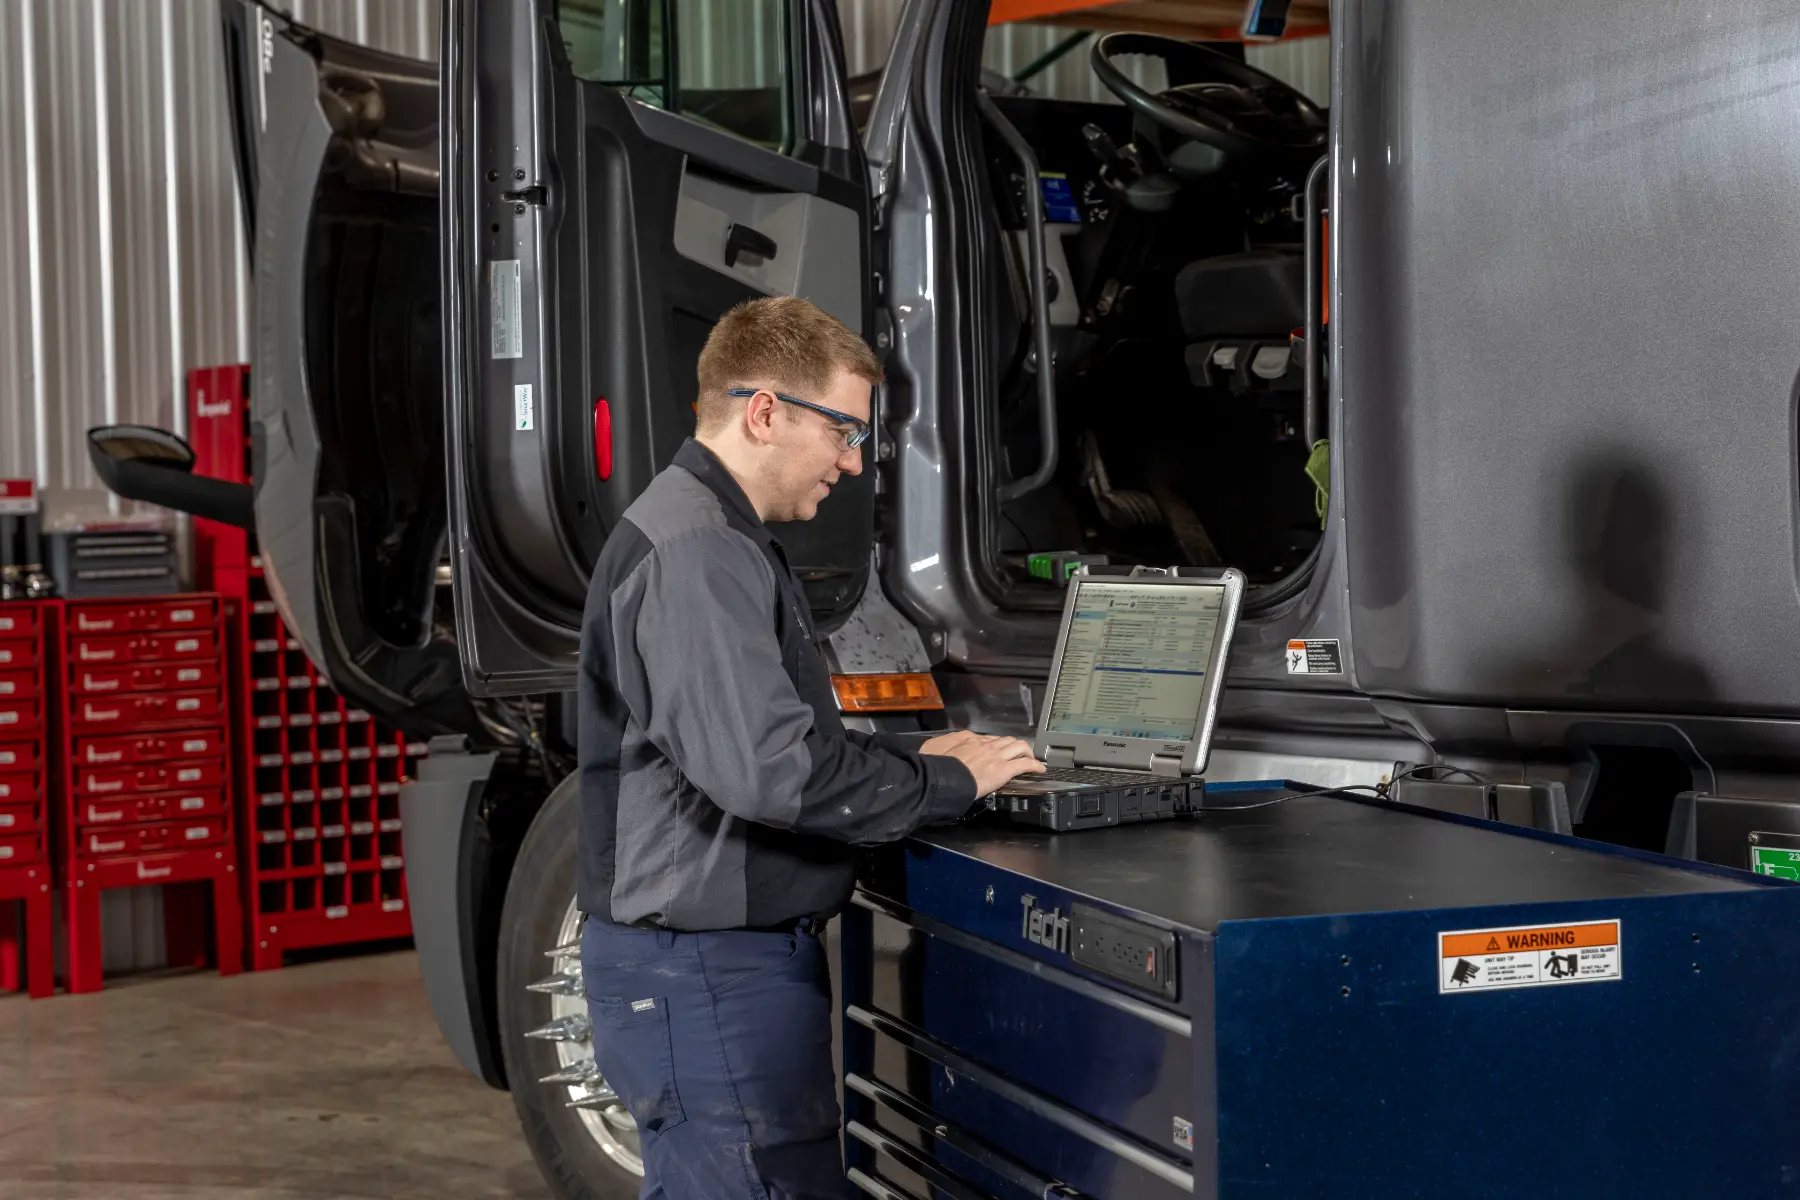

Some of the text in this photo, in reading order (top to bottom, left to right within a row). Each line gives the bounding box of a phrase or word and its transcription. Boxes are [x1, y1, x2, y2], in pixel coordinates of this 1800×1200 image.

[1103, 740, 1127, 749] Panasonic
[1020, 893, 1069, 954] Tech
[1506, 930, 1576, 949] WARNING
